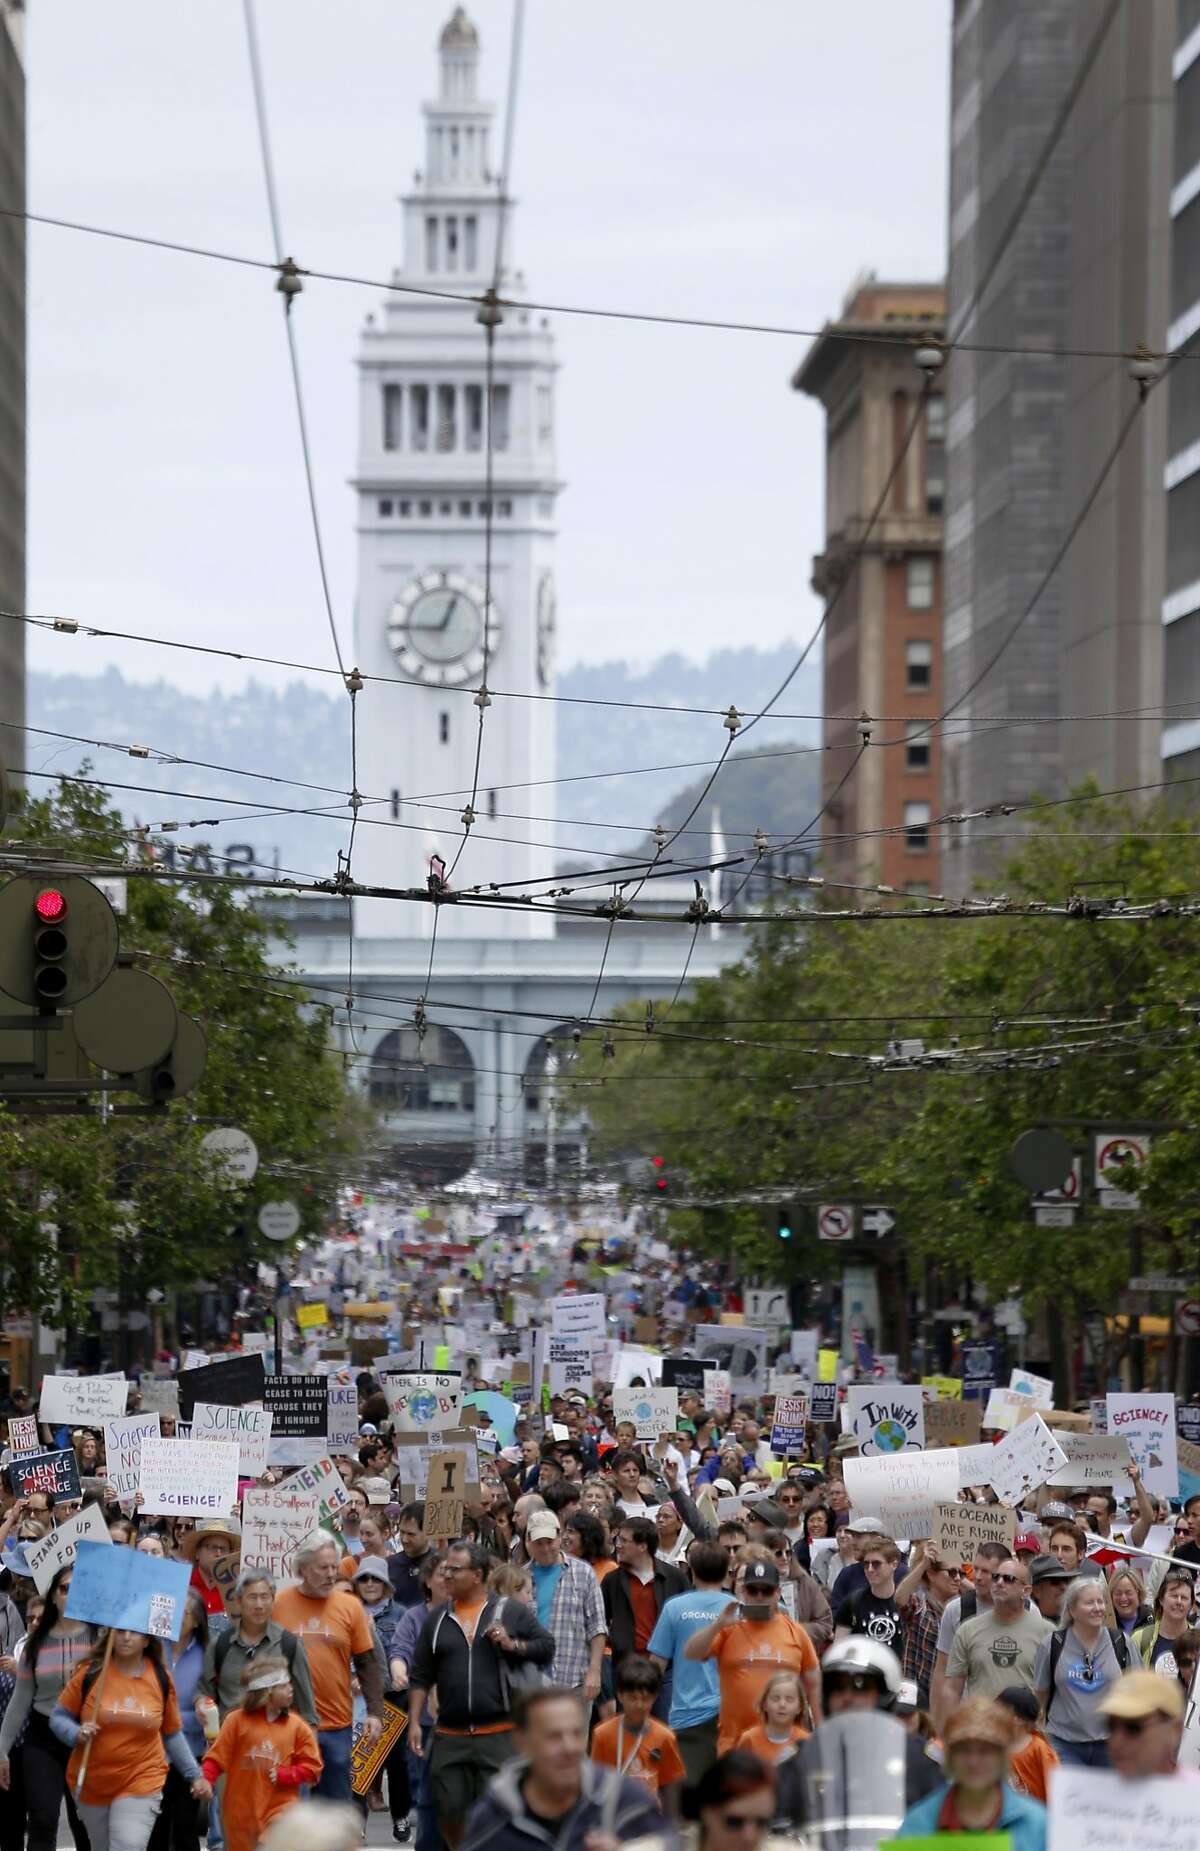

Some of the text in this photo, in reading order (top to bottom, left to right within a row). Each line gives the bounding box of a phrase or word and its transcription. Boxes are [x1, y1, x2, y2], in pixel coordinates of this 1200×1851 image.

[264, 1376, 321, 1385] FACTS DO NOT
[435, 1376, 450, 1388] NO
[265, 1389, 328, 1398] CEASE TO EXIST
[814, 1384, 835, 1400] NO!
[264, 1402, 323, 1411] BECAUSE THEY
[779, 1397, 805, 1412] RESIST
[284, 1416, 320, 1425] IGNORED
[777, 1411, 806, 1425] TRUMP
[1113, 1408, 1169, 1426] SCIENCE!
[18, 1460, 71, 1481] SCIENCE
[33, 1475, 57, 1487] NOT
[109, 1472, 141, 1494] SILEN
[159, 1493, 221, 1508] SCIENCE!
[939, 1505, 956, 1518] THE
[959, 1507, 1008, 1526] OCEANS
[76, 1521, 92, 1534] UP
[940, 1524, 965, 1537] ARE
[941, 1538, 958, 1549] BUT
[962, 1541, 975, 1549] SO
[31, 1533, 59, 1569] STAND
[244, 1555, 293, 1578] SCIEN
